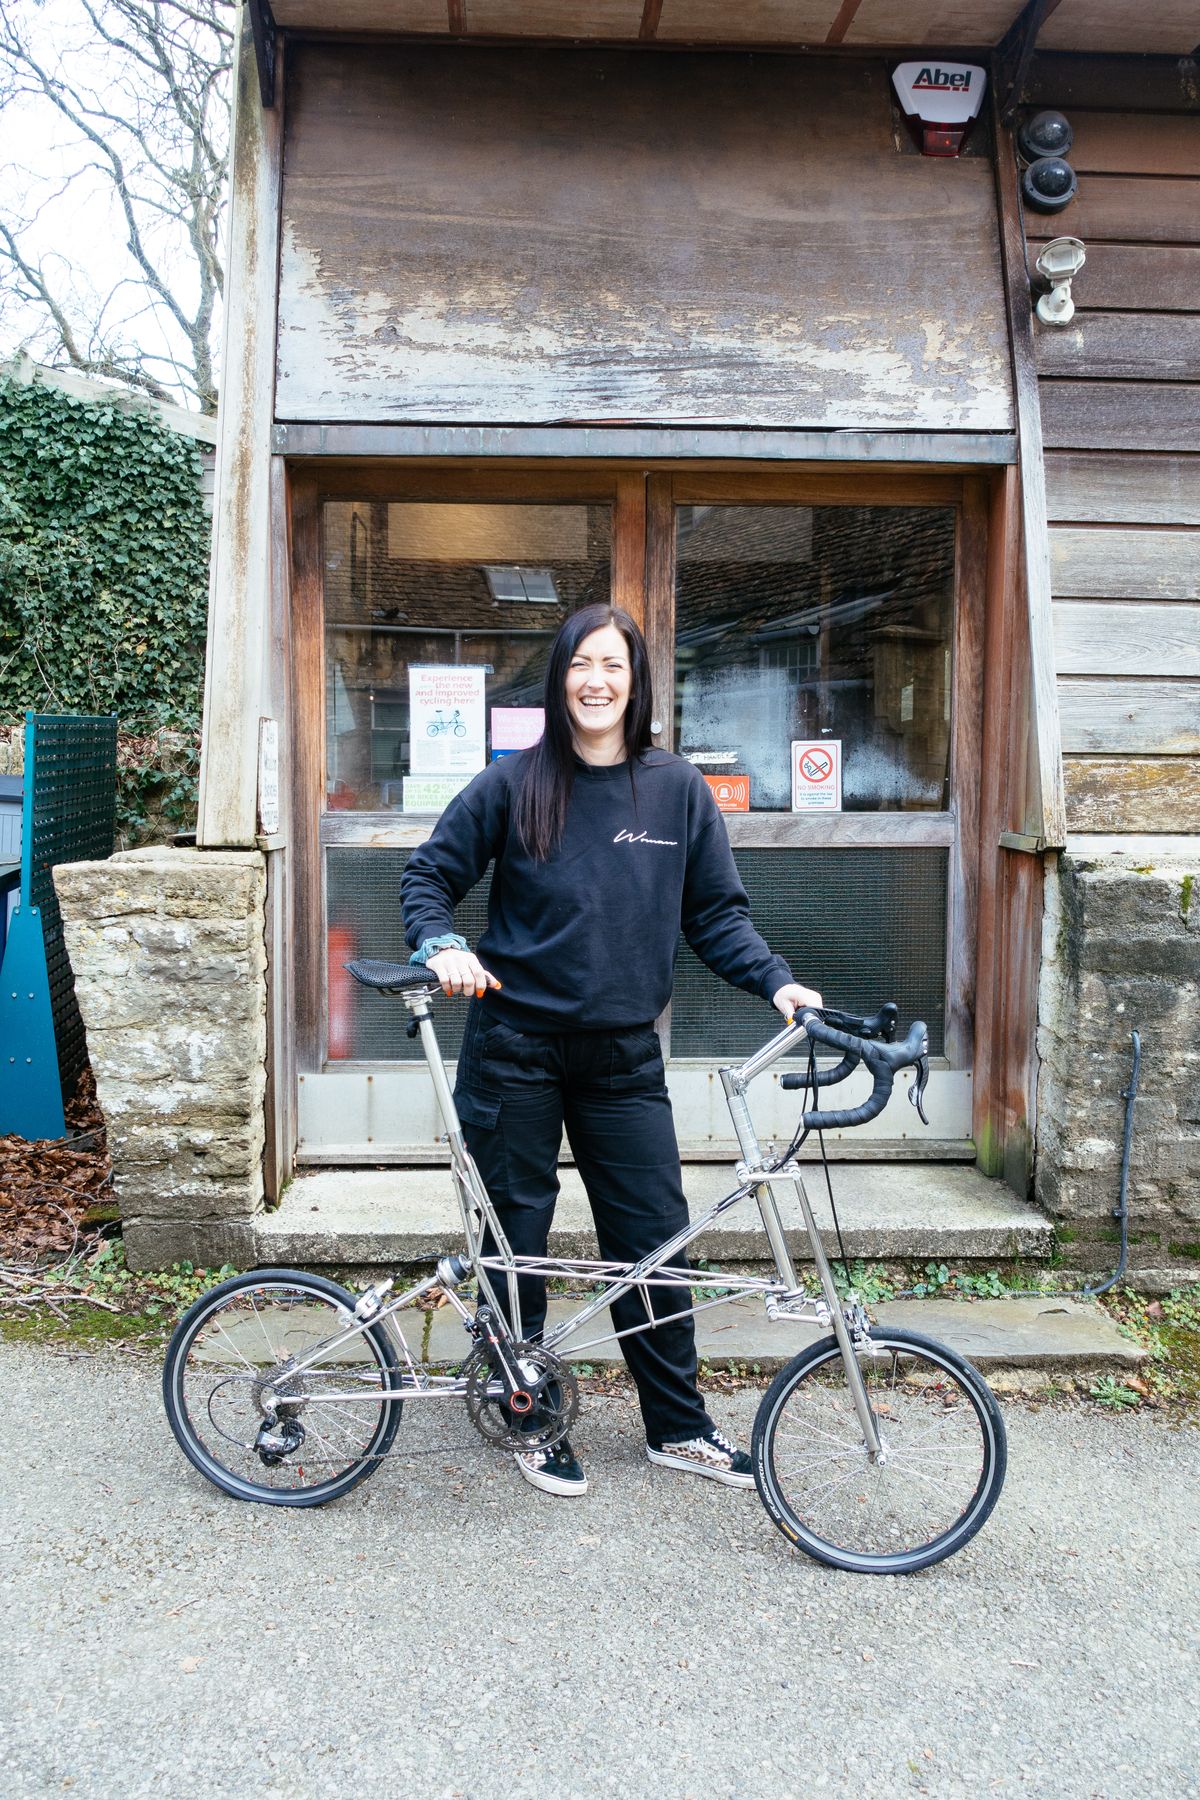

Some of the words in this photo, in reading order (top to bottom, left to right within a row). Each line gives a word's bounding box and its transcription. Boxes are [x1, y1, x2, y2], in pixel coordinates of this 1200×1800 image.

[913, 68, 972, 87] Abel
[421, 674, 473, 684] Experience
[435, 681, 451, 689] the
[435, 689, 480, 698] improved
[419, 697, 452, 706] cycling
[453, 697, 475, 705] here
[613, 829, 678, 846] Woman
